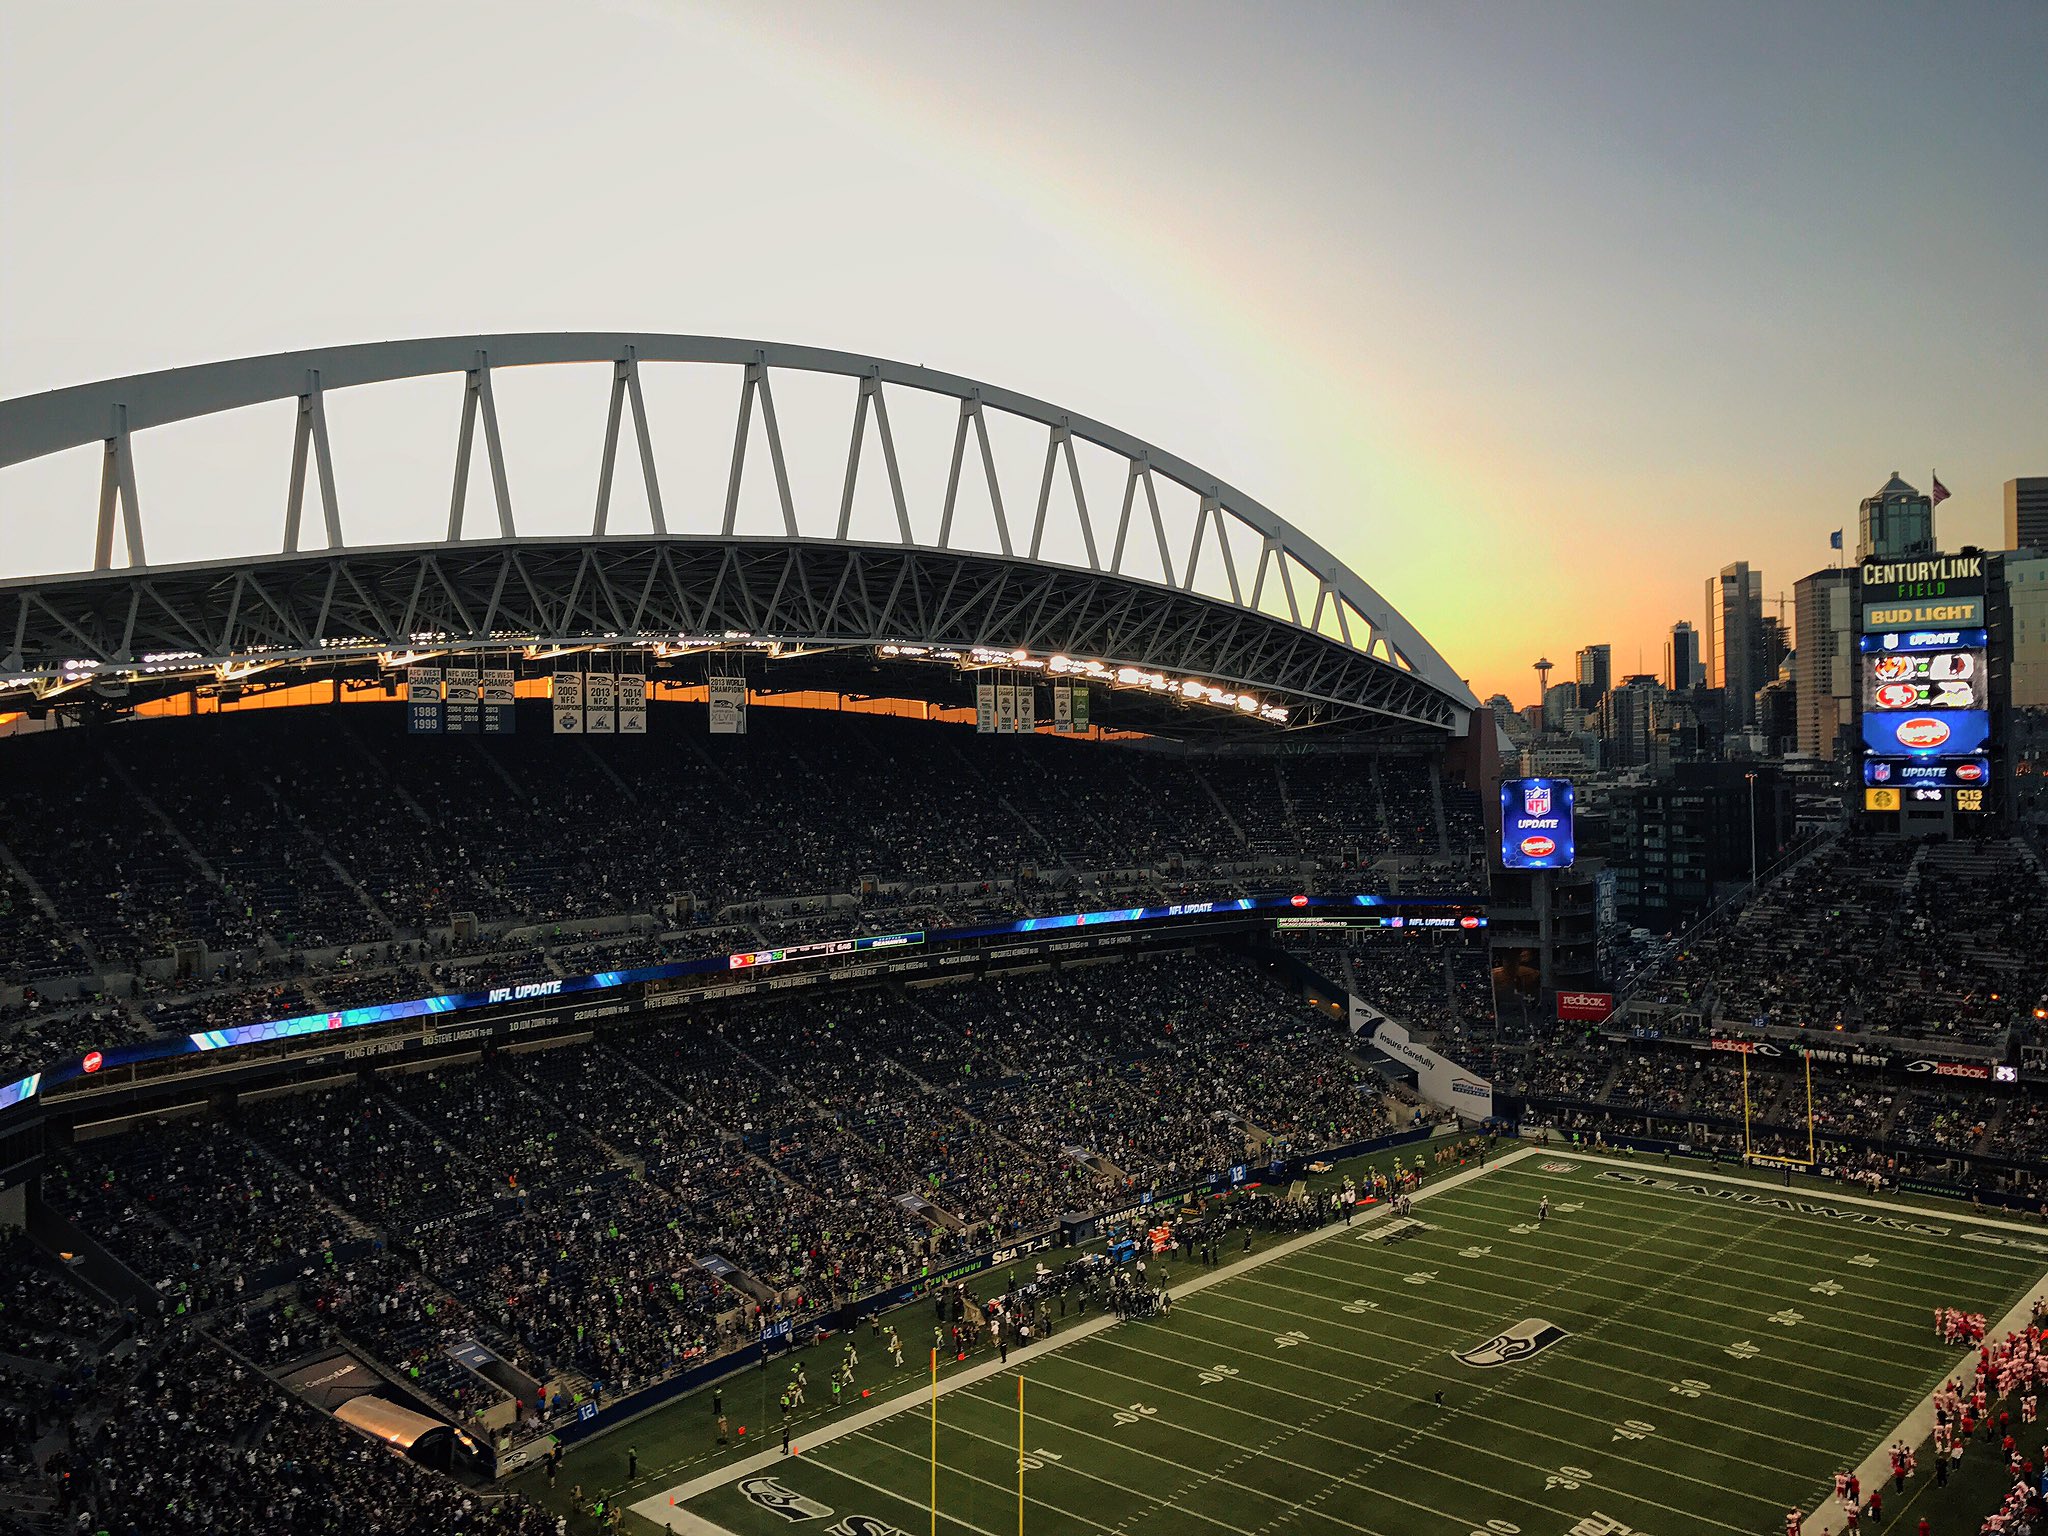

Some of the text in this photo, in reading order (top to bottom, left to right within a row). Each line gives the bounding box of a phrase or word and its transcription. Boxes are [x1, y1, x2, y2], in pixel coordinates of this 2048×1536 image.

[1863, 557, 1982, 585] CENTURYLINK
[1898, 582, 1946, 598] FIELD
[1872, 605, 1974, 624] BUD LIGHT
[1909, 632, 1960, 645] UPDATE
[410, 677, 440, 685] CHAMPS
[447, 678, 478, 686] CHAMPS
[484, 679, 513, 687] CHAMPS
[558, 687, 578, 695] 2005
[591, 688, 610, 697] 2013
[623, 689, 641, 697] 2014
[561, 696, 575, 704] NFC
[593, 697, 608, 705] NFC
[413, 707, 437, 717] 1988
[413, 719, 437, 729] 1999
[1902, 767, 1947, 777] UPDATE
[1957, 789, 1982, 800] Q13
[1528, 800, 1547, 812] NFL
[1958, 801, 1981, 811] FOX
[1518, 819, 1559, 829] UPDATE
[1169, 903, 1213, 916] NFL UPDATE
[1408, 918, 1424, 926] NFL
[1425, 918, 1455, 926] UPDATE
[746, 955, 755, 963] 13
[772, 951, 783, 960] 26
[489, 980, 562, 1003] NFL UPDATE
[648, 999, 661, 1009] PETE
[662, 997, 679, 1006] GROSS
[574, 1011, 583, 1020] 22
[509, 1022, 518, 1031] 10
[1755, 1018, 1764, 1027] 12
[422, 1036, 433, 1046] 80
[434, 1032, 452, 1045] STEVE
[454, 1028, 479, 1042] LARGENT
[1637, 1029, 1645, 1037] 12
[1650, 1030, 1658, 1038] 12
[1379, 1032, 1402, 1050] Insure
[344, 1042, 404, 1060] RING OF HONOR
[1403, 1046, 1435, 1071] Carefully
[1852, 1053, 1888, 1067] NEST
[1209, 1173, 1216, 1183] 12
[1233, 1167, 1244, 1182] 12
[1142, 1193, 1150, 1204] 12
[1594, 1171, 1951, 1236] SEAHAWKS
[1341, 1299, 1379, 1314] 50
[779, 1321, 788, 1334] 12
[763, 1328, 772, 1339] 12
[1669, 1379, 1711, 1398] 50
[581, 1404, 595, 1420] 12
[1614, 1419, 1656, 1440] 40
[1545, 1466, 1593, 1490] 30
